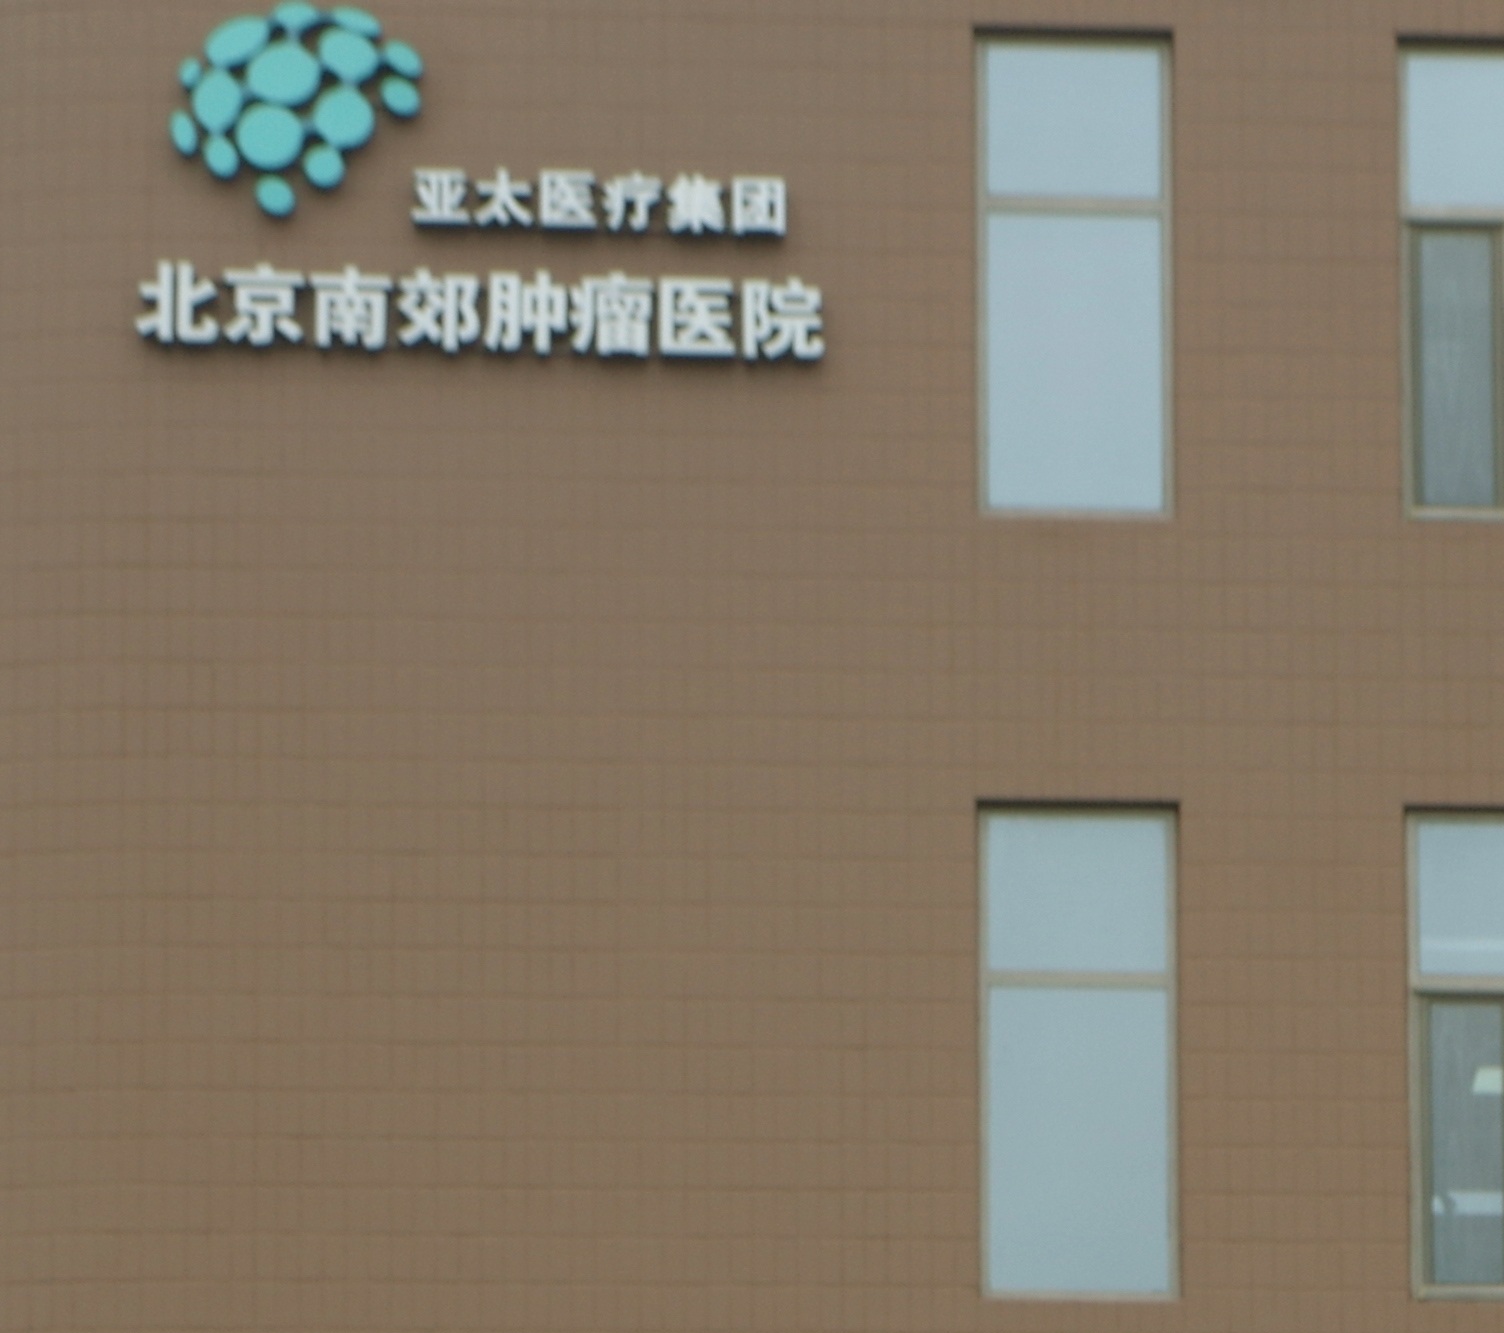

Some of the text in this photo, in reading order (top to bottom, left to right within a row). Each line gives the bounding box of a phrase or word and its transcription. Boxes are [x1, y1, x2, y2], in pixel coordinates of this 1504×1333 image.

[411, 167, 788, 237] 亚太医疗集团
[135, 260, 826, 362] 北京南郊肿瘤医院
